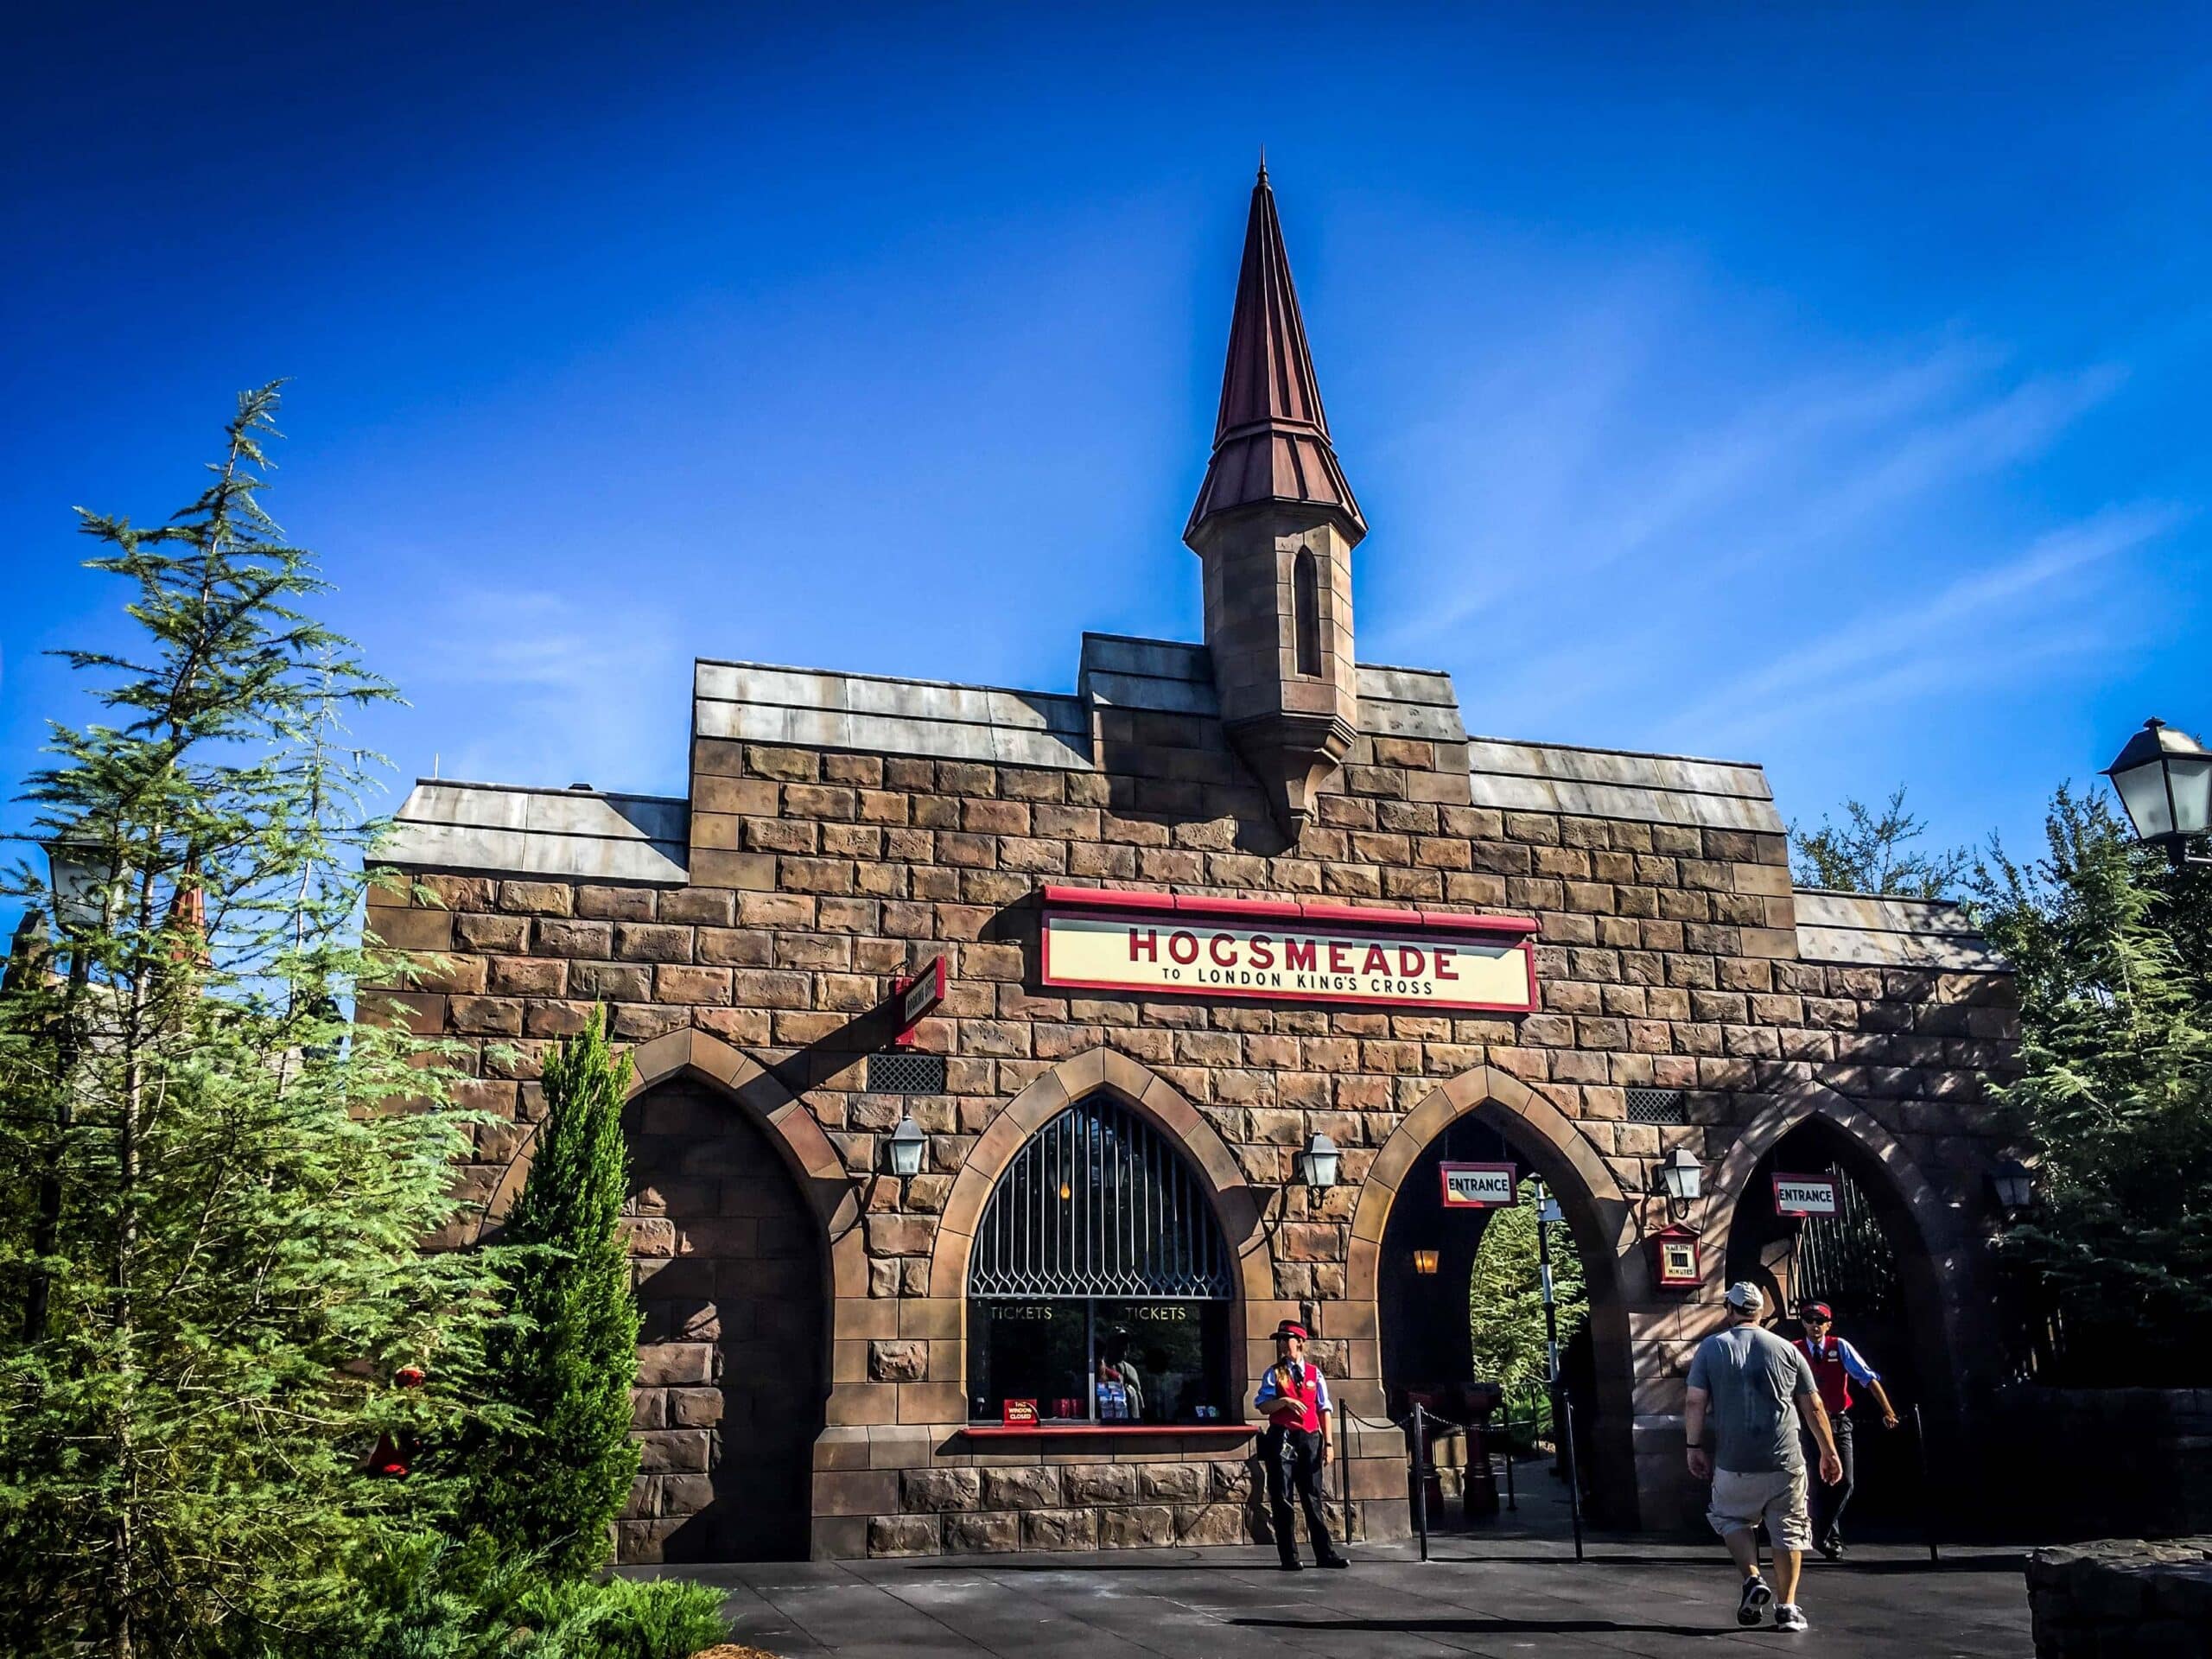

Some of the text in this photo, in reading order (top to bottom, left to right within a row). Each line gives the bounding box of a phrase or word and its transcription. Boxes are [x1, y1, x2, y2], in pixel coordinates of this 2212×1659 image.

[1128, 927, 1459, 981] HOGSMEADE
[1162, 968, 1433, 995] TO LONDON KING'S CROSS
[1448, 1178, 1509, 1192] ENTRANCE
[1779, 1188, 1832, 1203] ENTRANCE
[989, 1306, 1052, 1320] TICKETS
[1124, 1306, 1186, 1321] TICKETS
